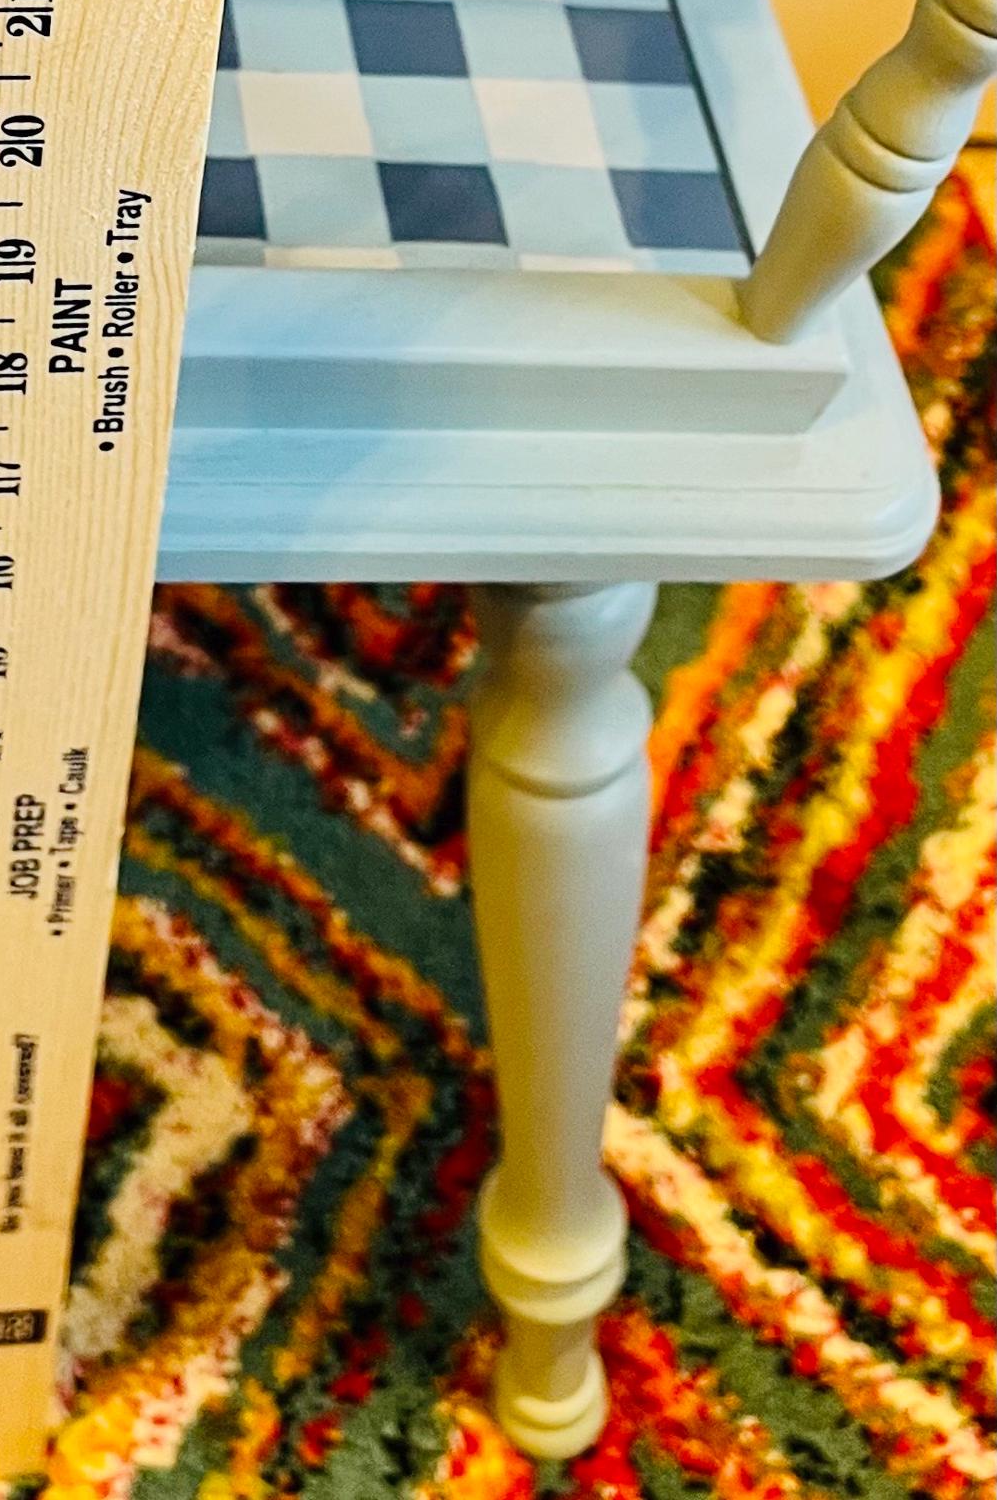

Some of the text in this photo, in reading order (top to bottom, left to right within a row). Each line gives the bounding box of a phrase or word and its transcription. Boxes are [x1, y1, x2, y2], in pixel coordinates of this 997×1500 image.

[0, 114, 45, 168] 20
[49, 278, 92, 373] PAINT
[93, 189, 152, 434] Brush Roller Tray
[8, 793, 46, 899] JOB PREP
[46, 746, 89, 924] Primer Tape Caulk
